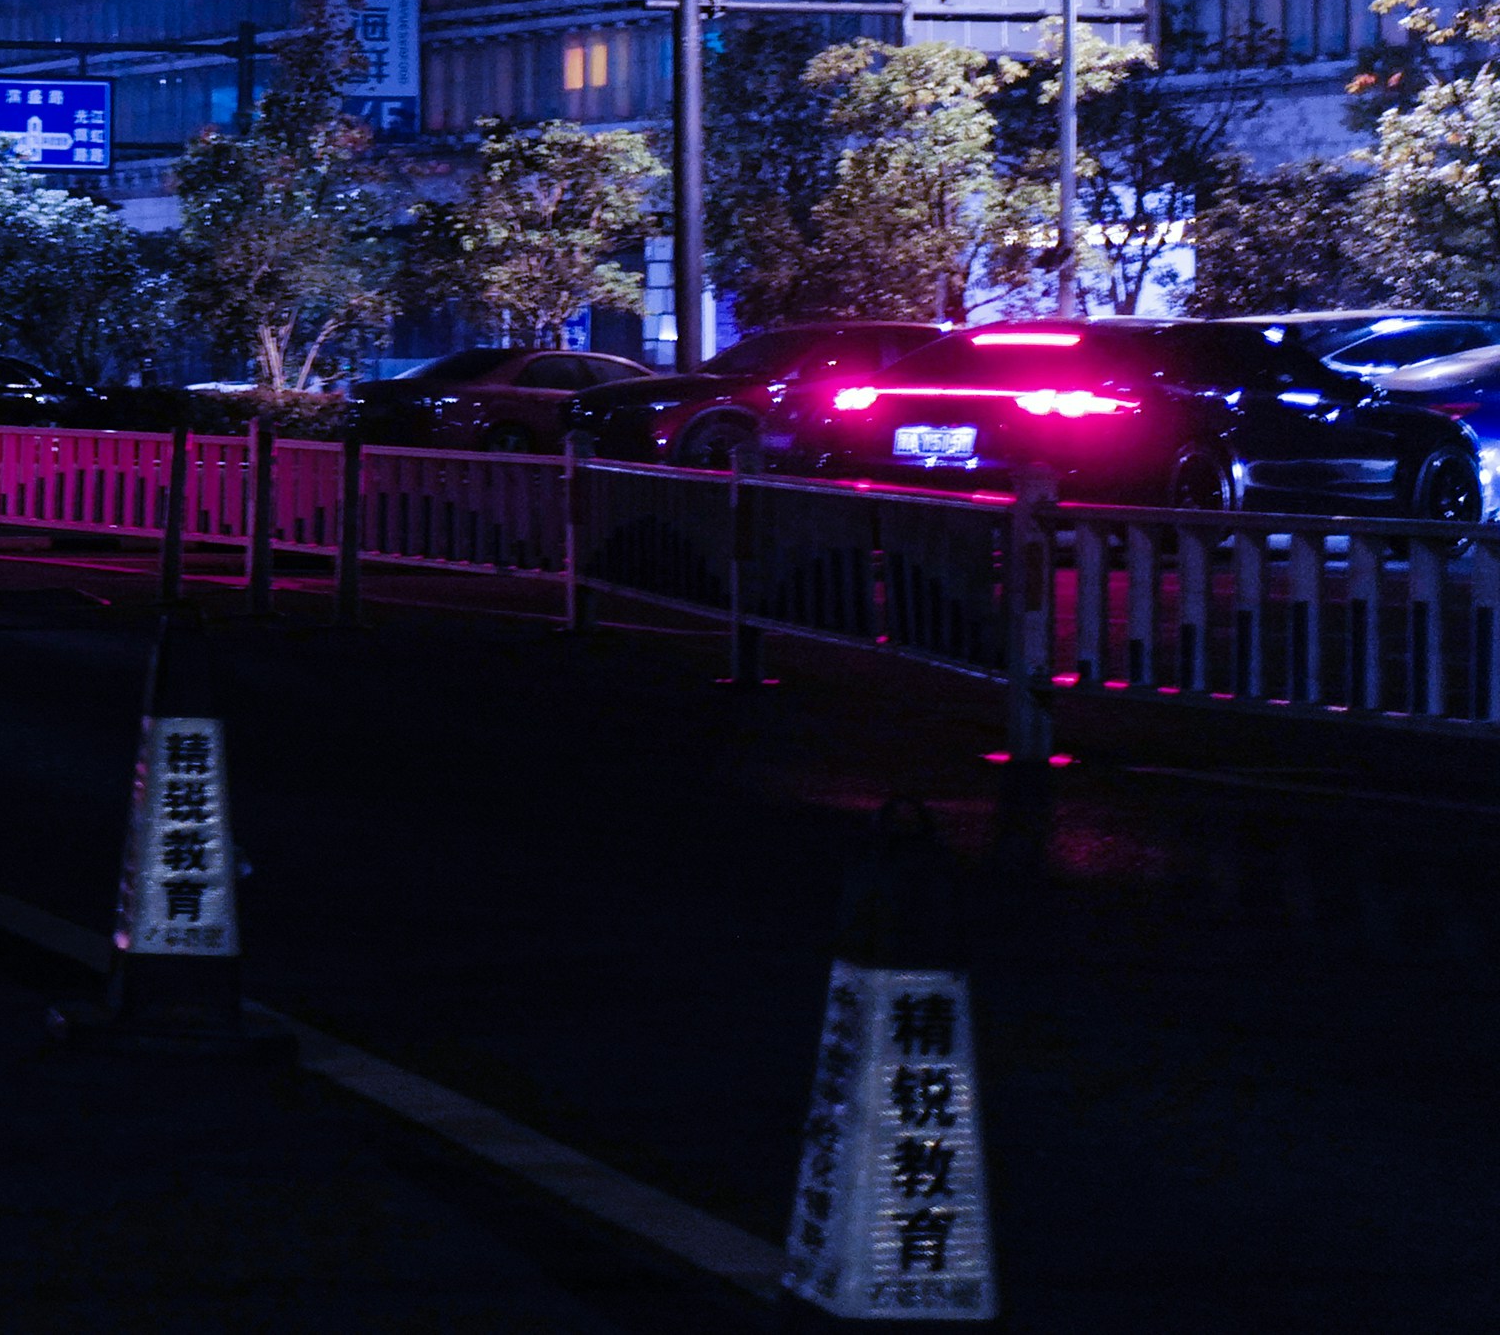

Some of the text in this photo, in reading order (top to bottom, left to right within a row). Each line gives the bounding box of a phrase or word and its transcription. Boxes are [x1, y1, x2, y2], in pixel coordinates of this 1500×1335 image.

[163, 733, 211, 921] 精锐教育
[893, 993, 956, 1272] 精锐教育
